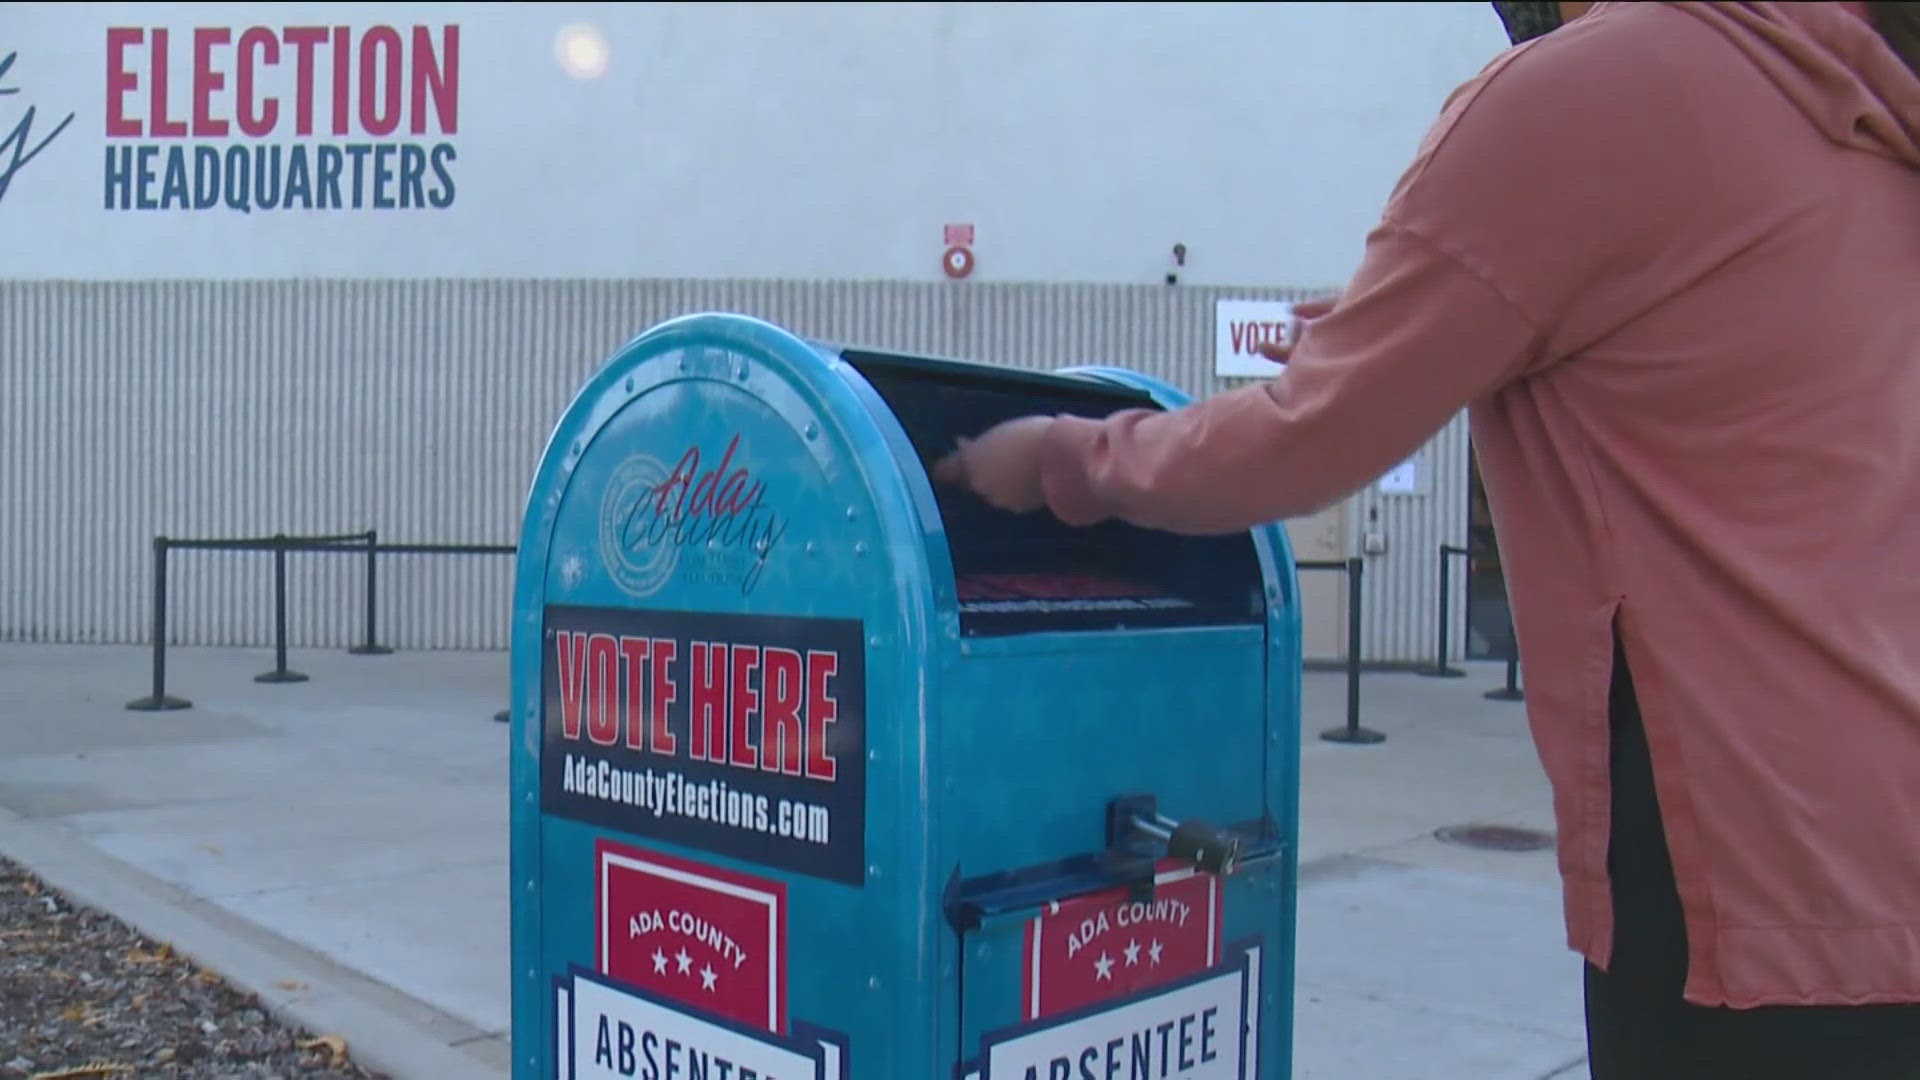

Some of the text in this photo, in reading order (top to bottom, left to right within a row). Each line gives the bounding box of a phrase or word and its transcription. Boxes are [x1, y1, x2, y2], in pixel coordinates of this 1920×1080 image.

[105, 24, 460, 137] ELECTION
[104, 142, 457, 213] HEADQUARTERS
[653, 433, 760, 518] Ada
[622, 480, 788, 595] County
[557, 630, 838, 783] VOTE HERE
[563, 754, 830, 845] AdaCountyElections.com
[629, 910, 748, 970] ADA COUNTY
[1067, 898, 1190, 960] ADA COUNTY
